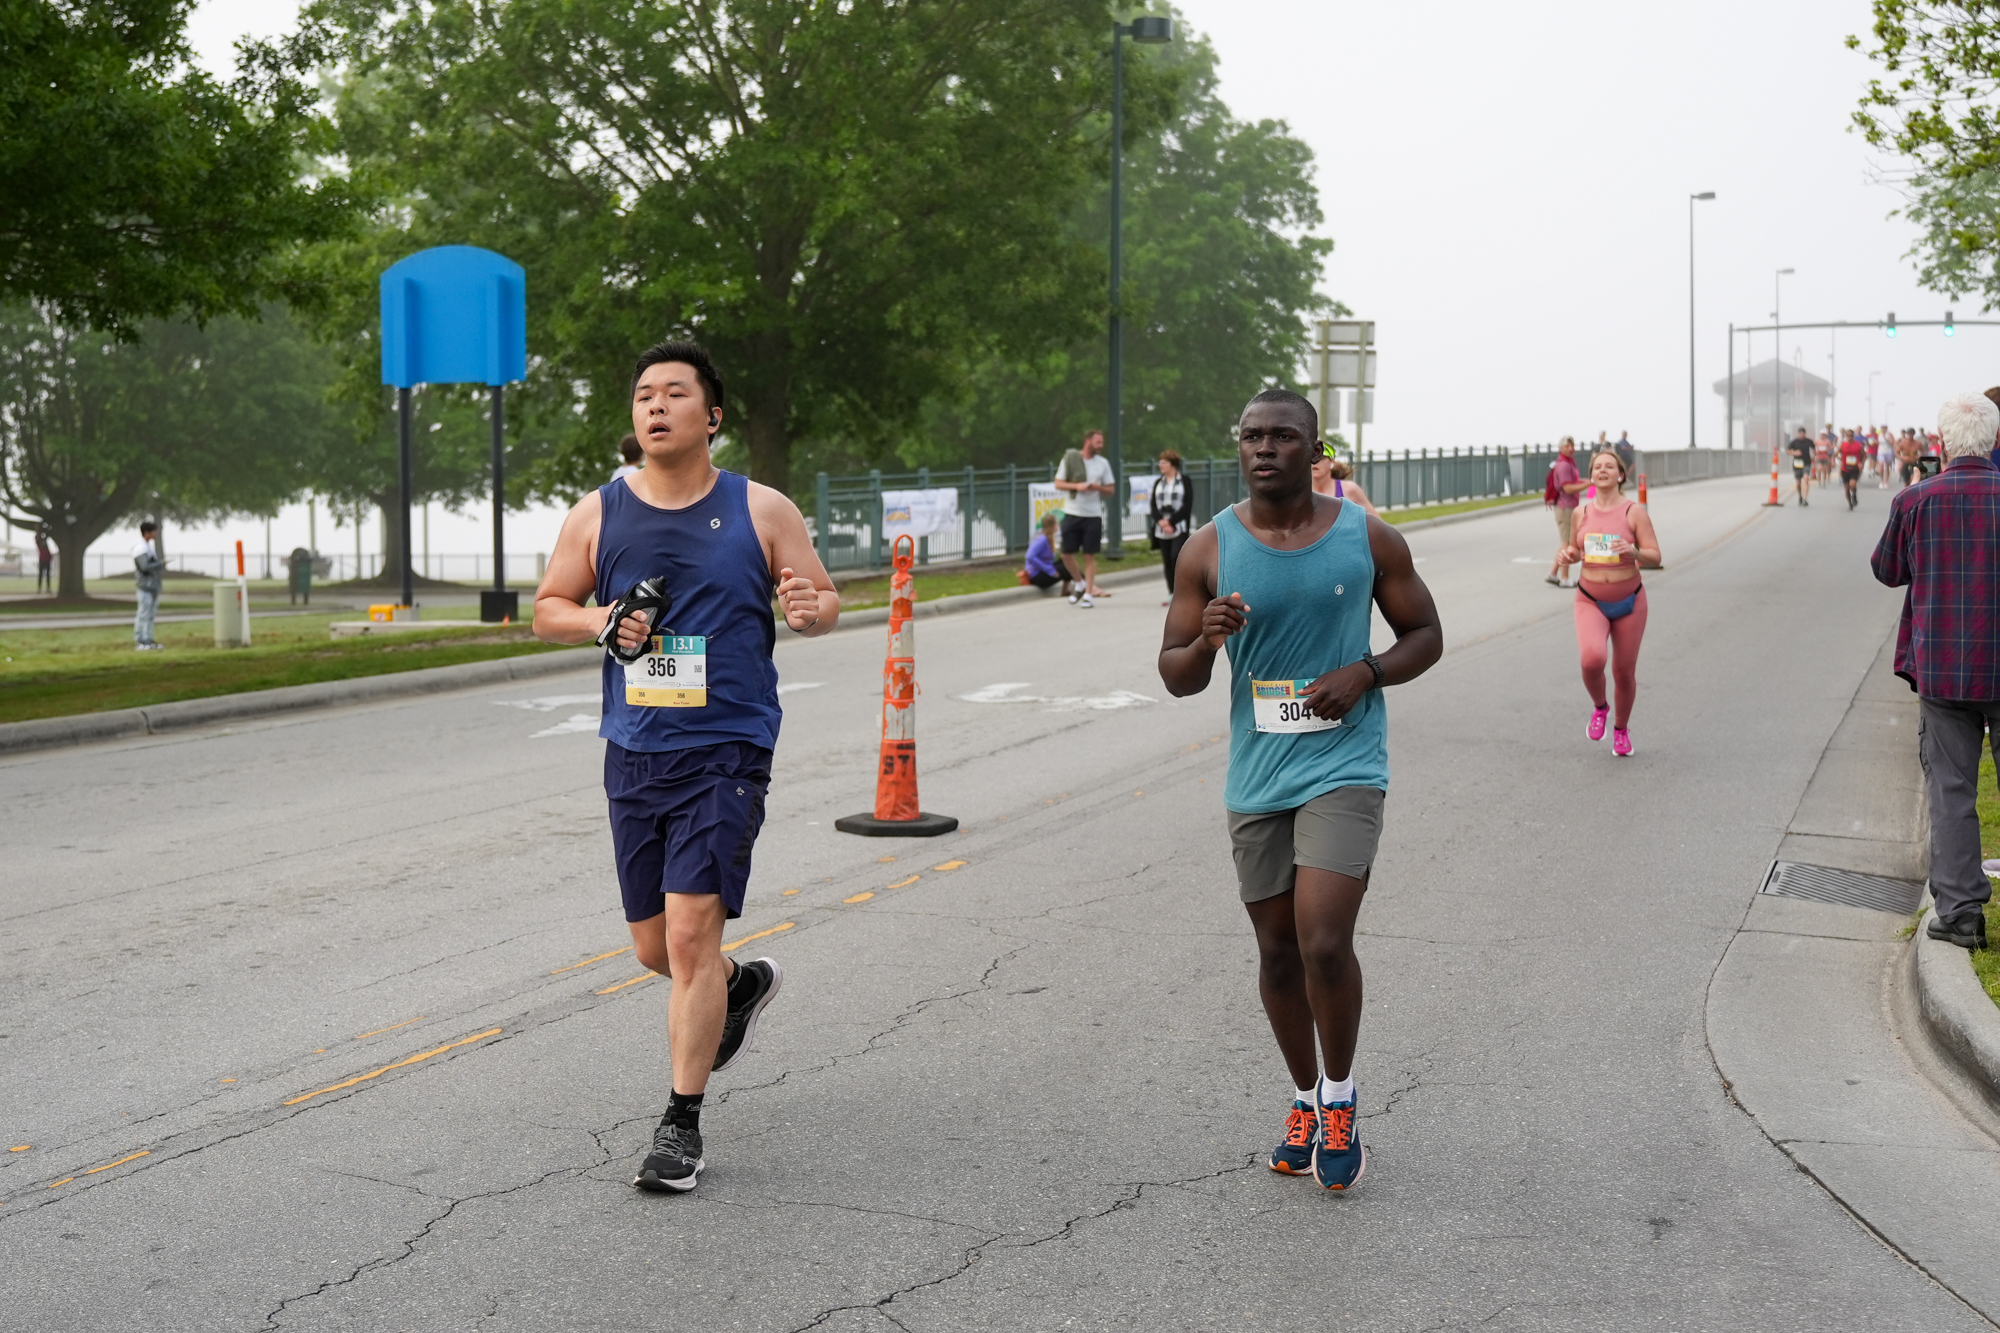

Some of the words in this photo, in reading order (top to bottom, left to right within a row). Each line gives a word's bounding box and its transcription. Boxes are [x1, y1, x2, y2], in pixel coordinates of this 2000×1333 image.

[672, 637, 694, 650] 13.1
[647, 657, 676, 677] 356
[1256, 686, 1286, 696] BRIDGE
